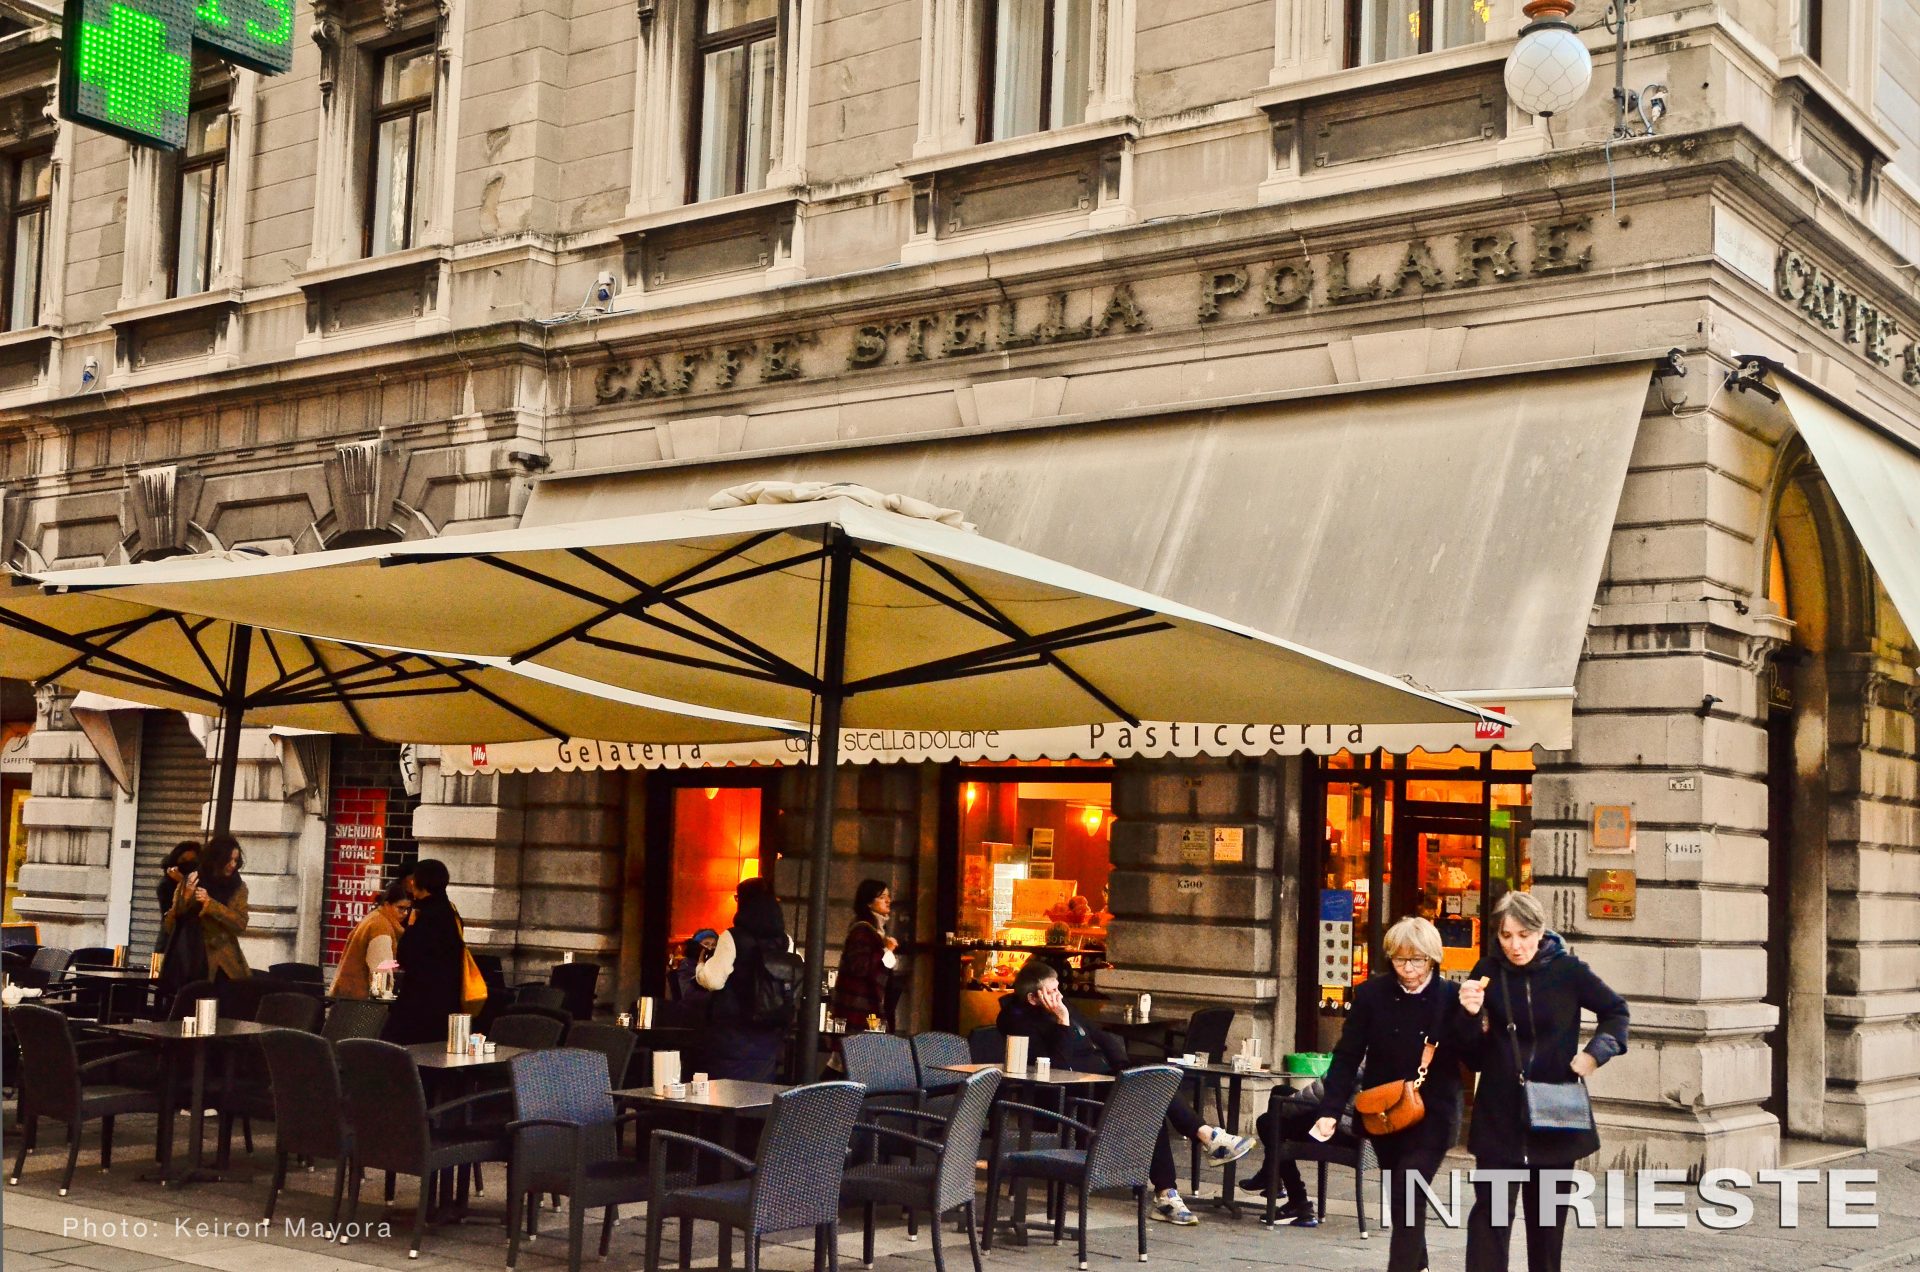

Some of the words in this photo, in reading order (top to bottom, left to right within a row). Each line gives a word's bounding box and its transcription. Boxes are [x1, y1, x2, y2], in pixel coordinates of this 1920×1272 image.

[847, 283, 1153, 370] STELLA
[1199, 212, 1594, 324] POLARE
[1090, 722, 1363, 749] Pasticceria
[474, 747, 486, 763] illy
[557, 739, 701, 763] Gelateria
[335, 825, 383, 839] SVENDITA
[340, 844, 375, 860] TOTALE
